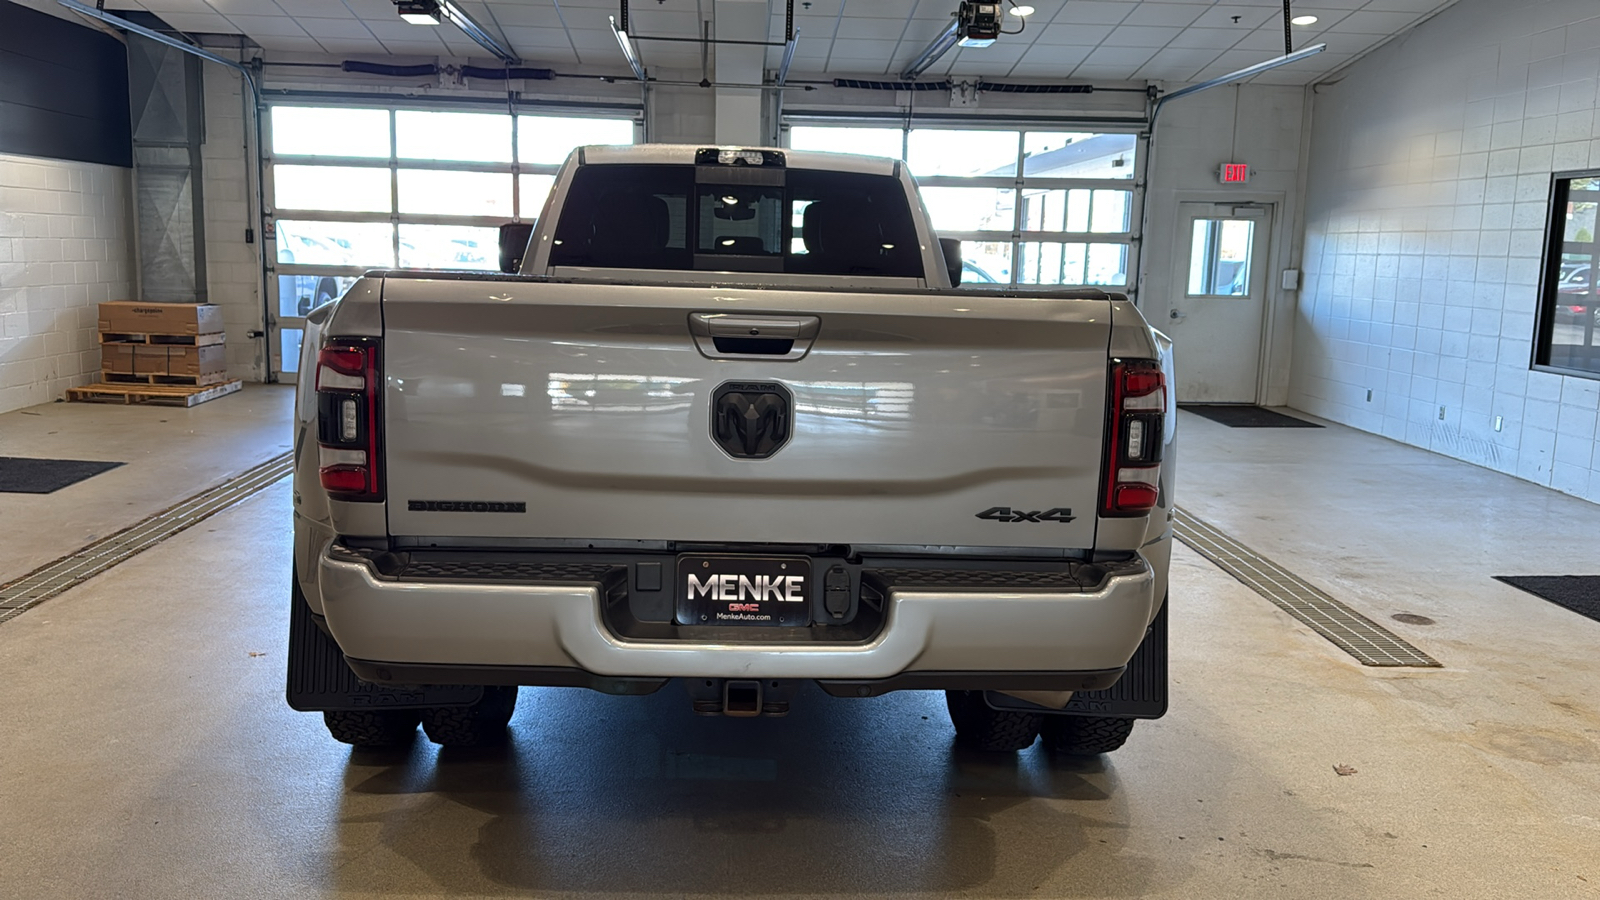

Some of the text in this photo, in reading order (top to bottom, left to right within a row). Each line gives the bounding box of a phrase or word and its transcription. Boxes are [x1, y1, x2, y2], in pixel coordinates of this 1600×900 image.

[1225, 164, 1247, 182] EXIT
[407, 499, 526, 513] BIGHORN
[687, 573, 804, 602] MENKE
[728, 603, 759, 612] GMC
[716, 612, 771, 621] MenkeAuto.com
[347, 693, 426, 705] RAM
